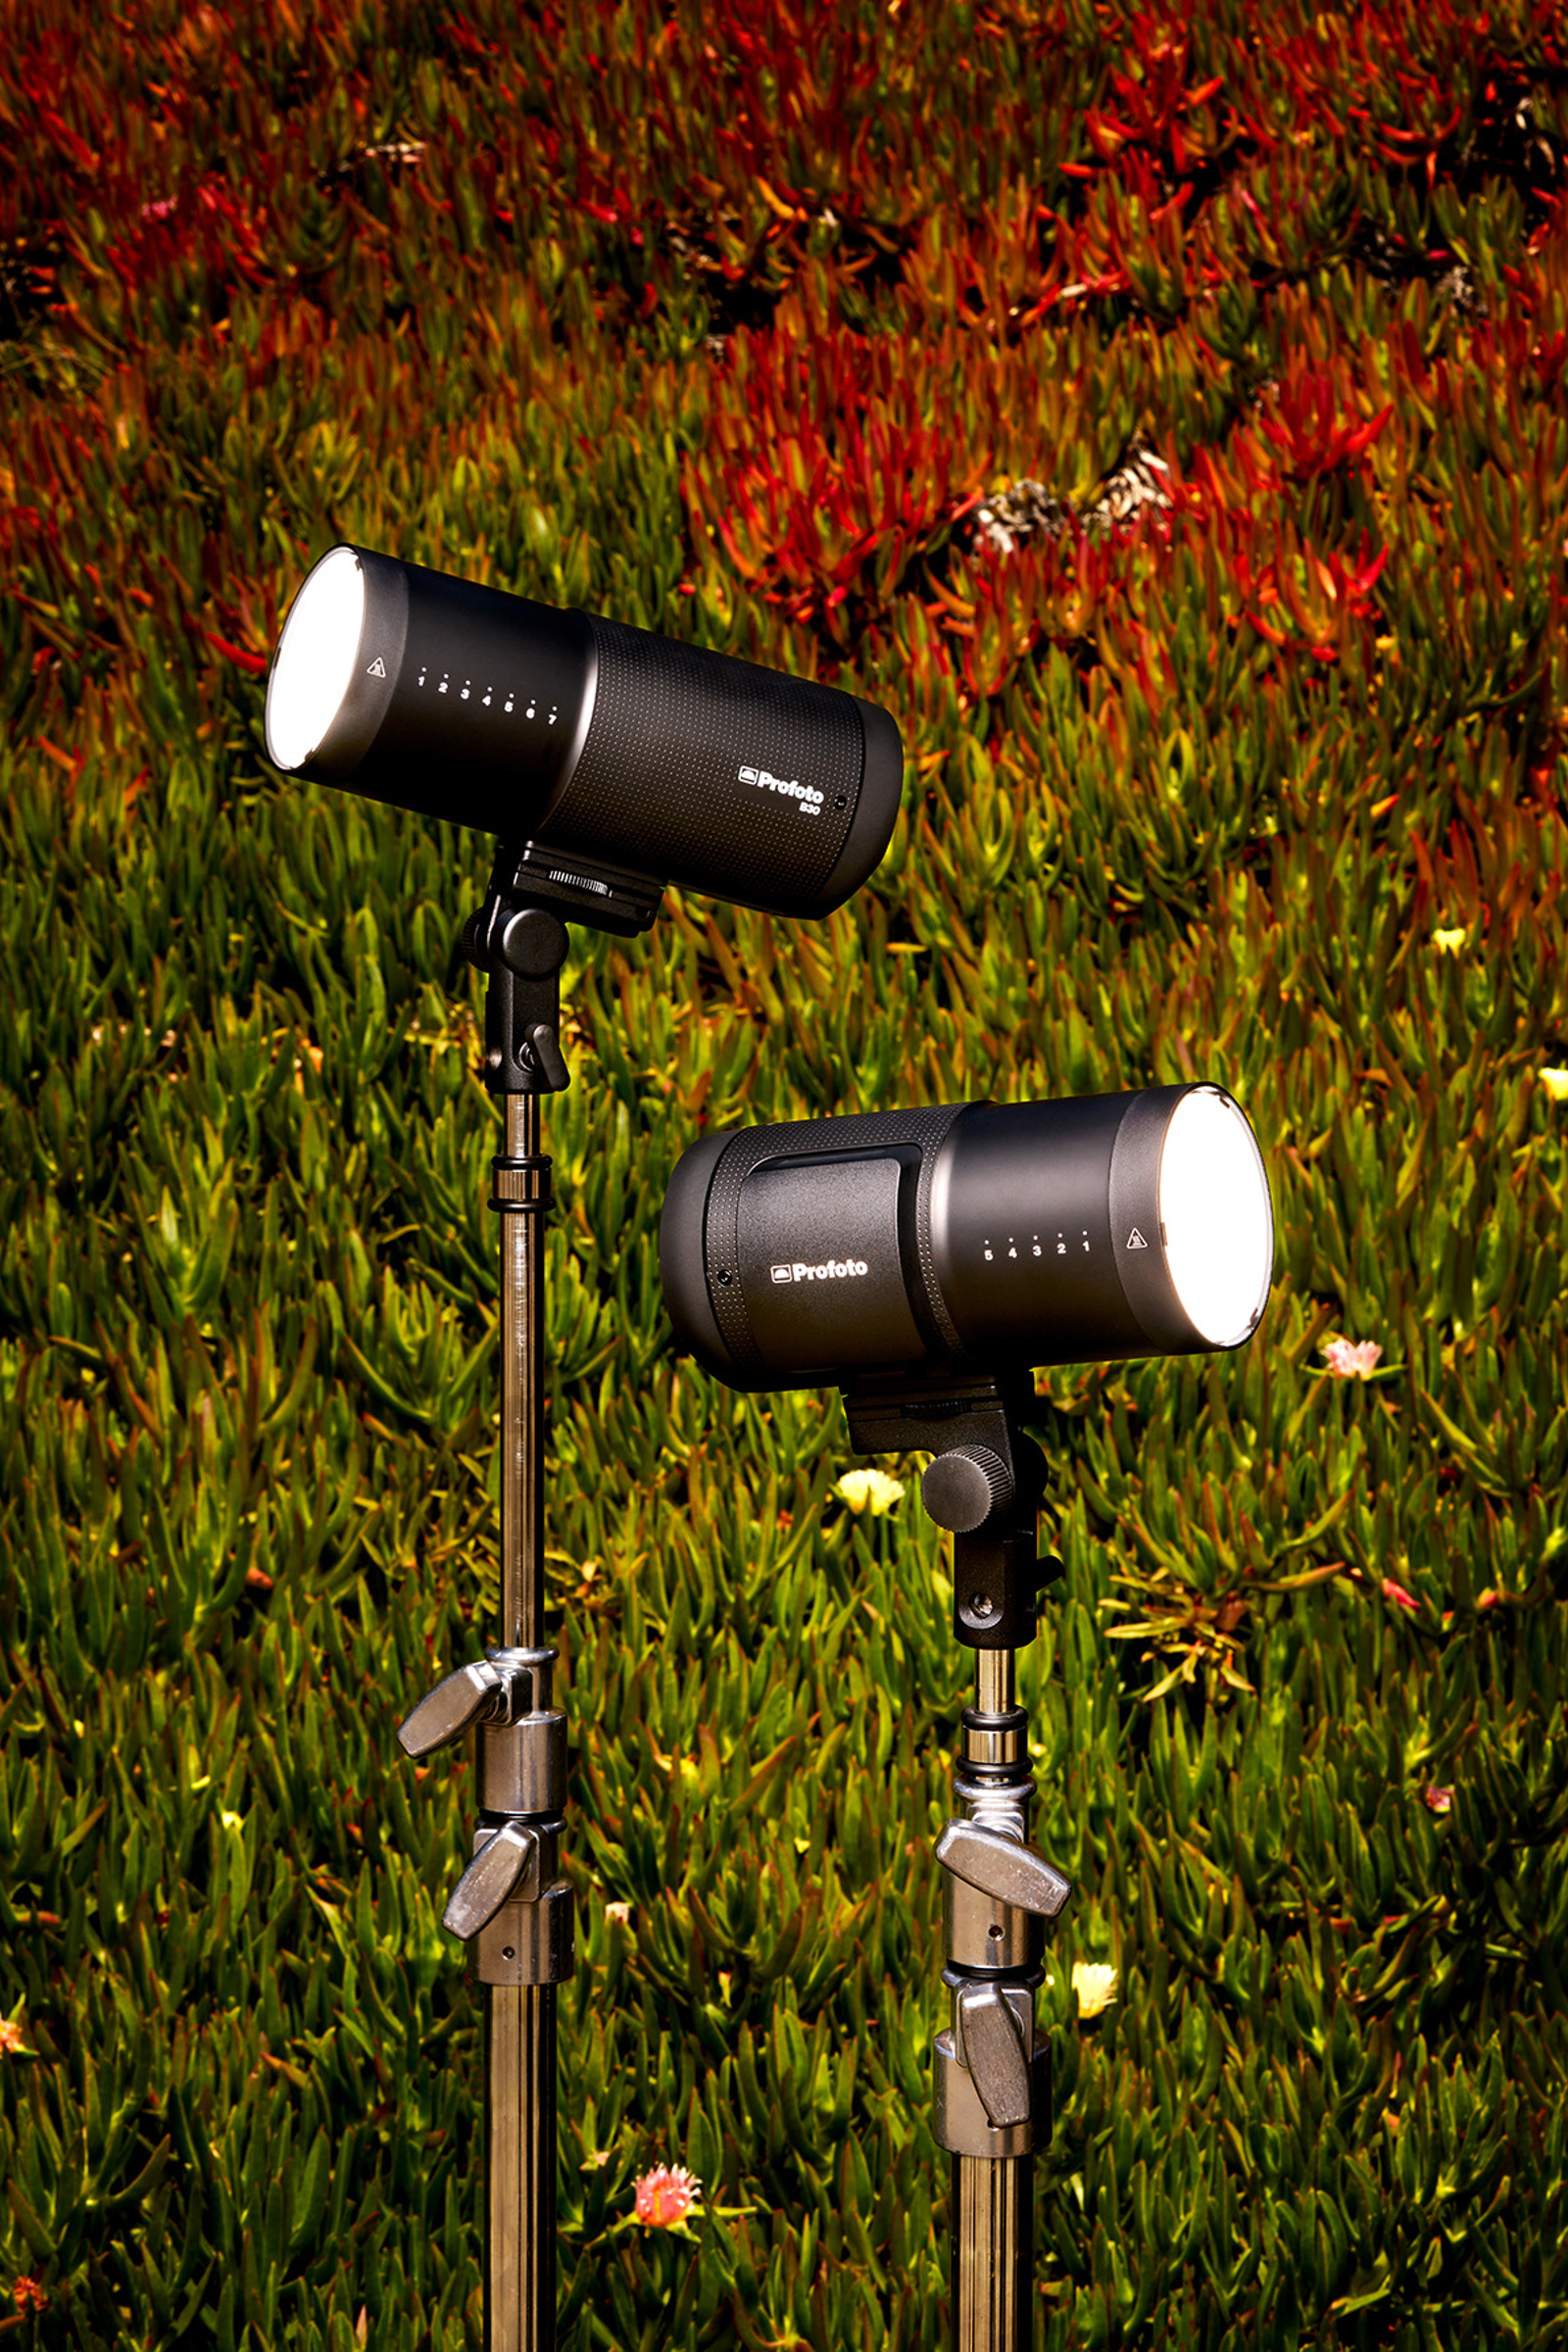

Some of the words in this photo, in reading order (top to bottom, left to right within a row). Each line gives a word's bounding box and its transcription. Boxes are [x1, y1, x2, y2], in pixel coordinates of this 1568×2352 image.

[417, 675, 425, 687] 1
[437, 681, 449, 694] 2
[460, 688, 470, 700] 3
[481, 695, 492, 707] 4
[504, 701, 514, 712] 5
[525, 708, 536, 719] 6
[548, 713, 558, 725] 7
[757, 770, 825, 805] Profoto
[799, 801, 821, 816] B30
[984, 1249, 994, 1261] 5
[1007, 1247, 1018, 1259] 4
[1032, 1245, 1043, 1257] 3
[1056, 1243, 1067, 1254] 2
[1082, 1240, 1091, 1252] 1
[792, 1258, 869, 1283] Profoto
